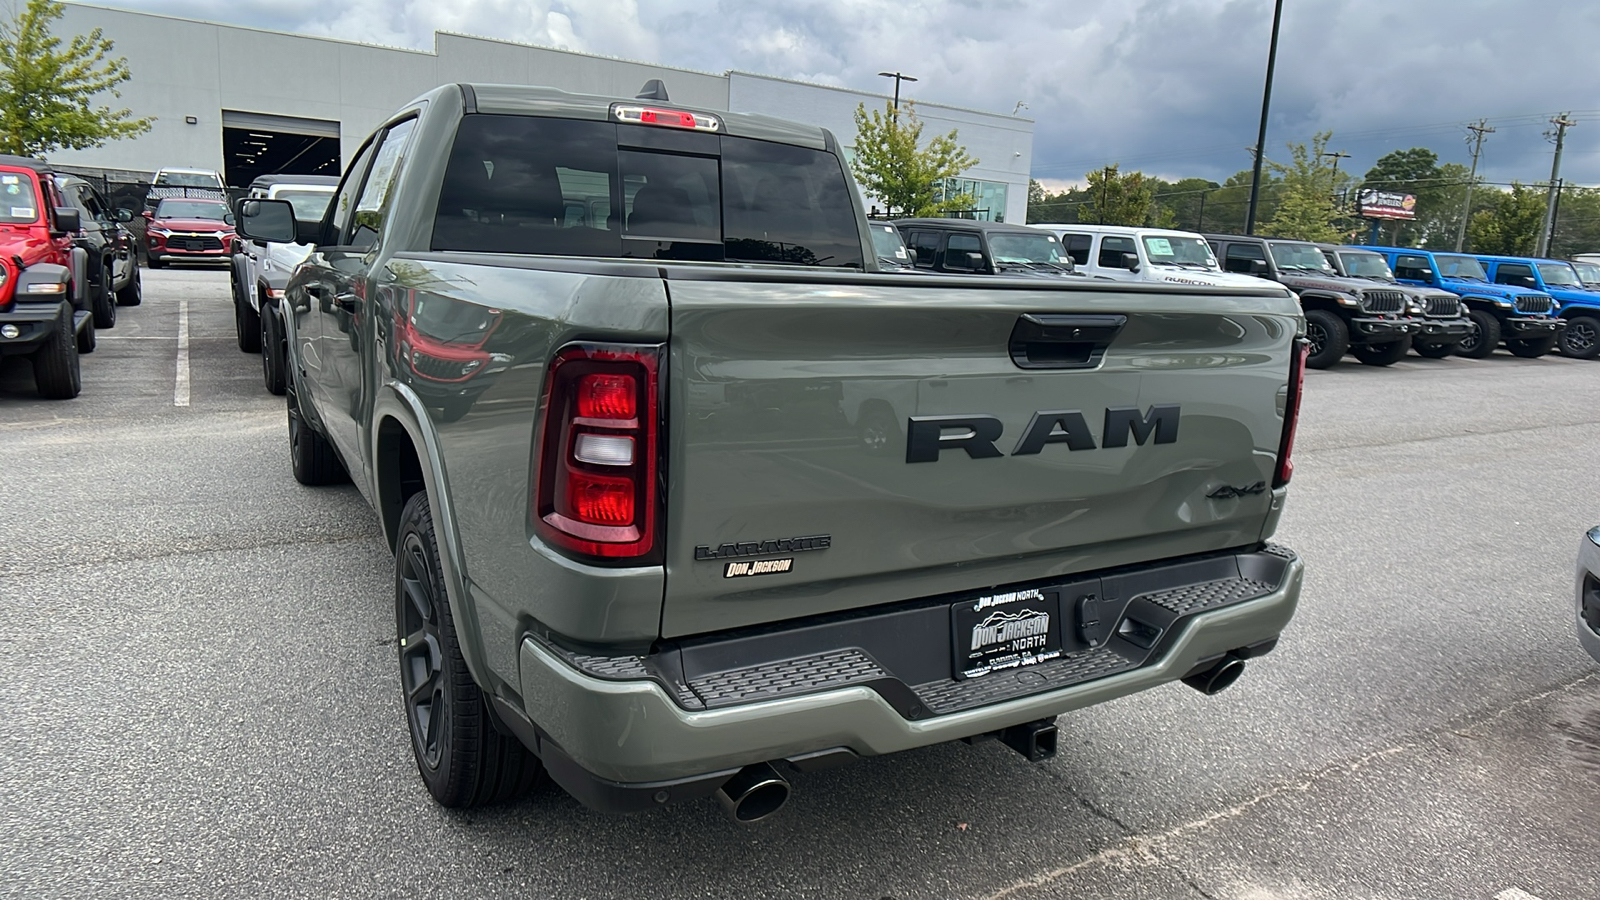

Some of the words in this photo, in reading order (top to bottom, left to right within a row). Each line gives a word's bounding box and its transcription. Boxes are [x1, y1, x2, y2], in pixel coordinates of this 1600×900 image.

[906, 404, 1181, 464] RAM
[695, 534, 831, 560] LARAMIE
[727, 562, 749, 577] DON
[748, 559, 791, 575] JACKSON
[978, 597, 991, 608] DON
[992, 593, 1016, 606] JACKSON
[1017, 589, 1039, 601] NORTH
[971, 627, 997, 651] DON
[997, 616, 1049, 642] JACKSON
[1012, 634, 1046, 651] NORTH
